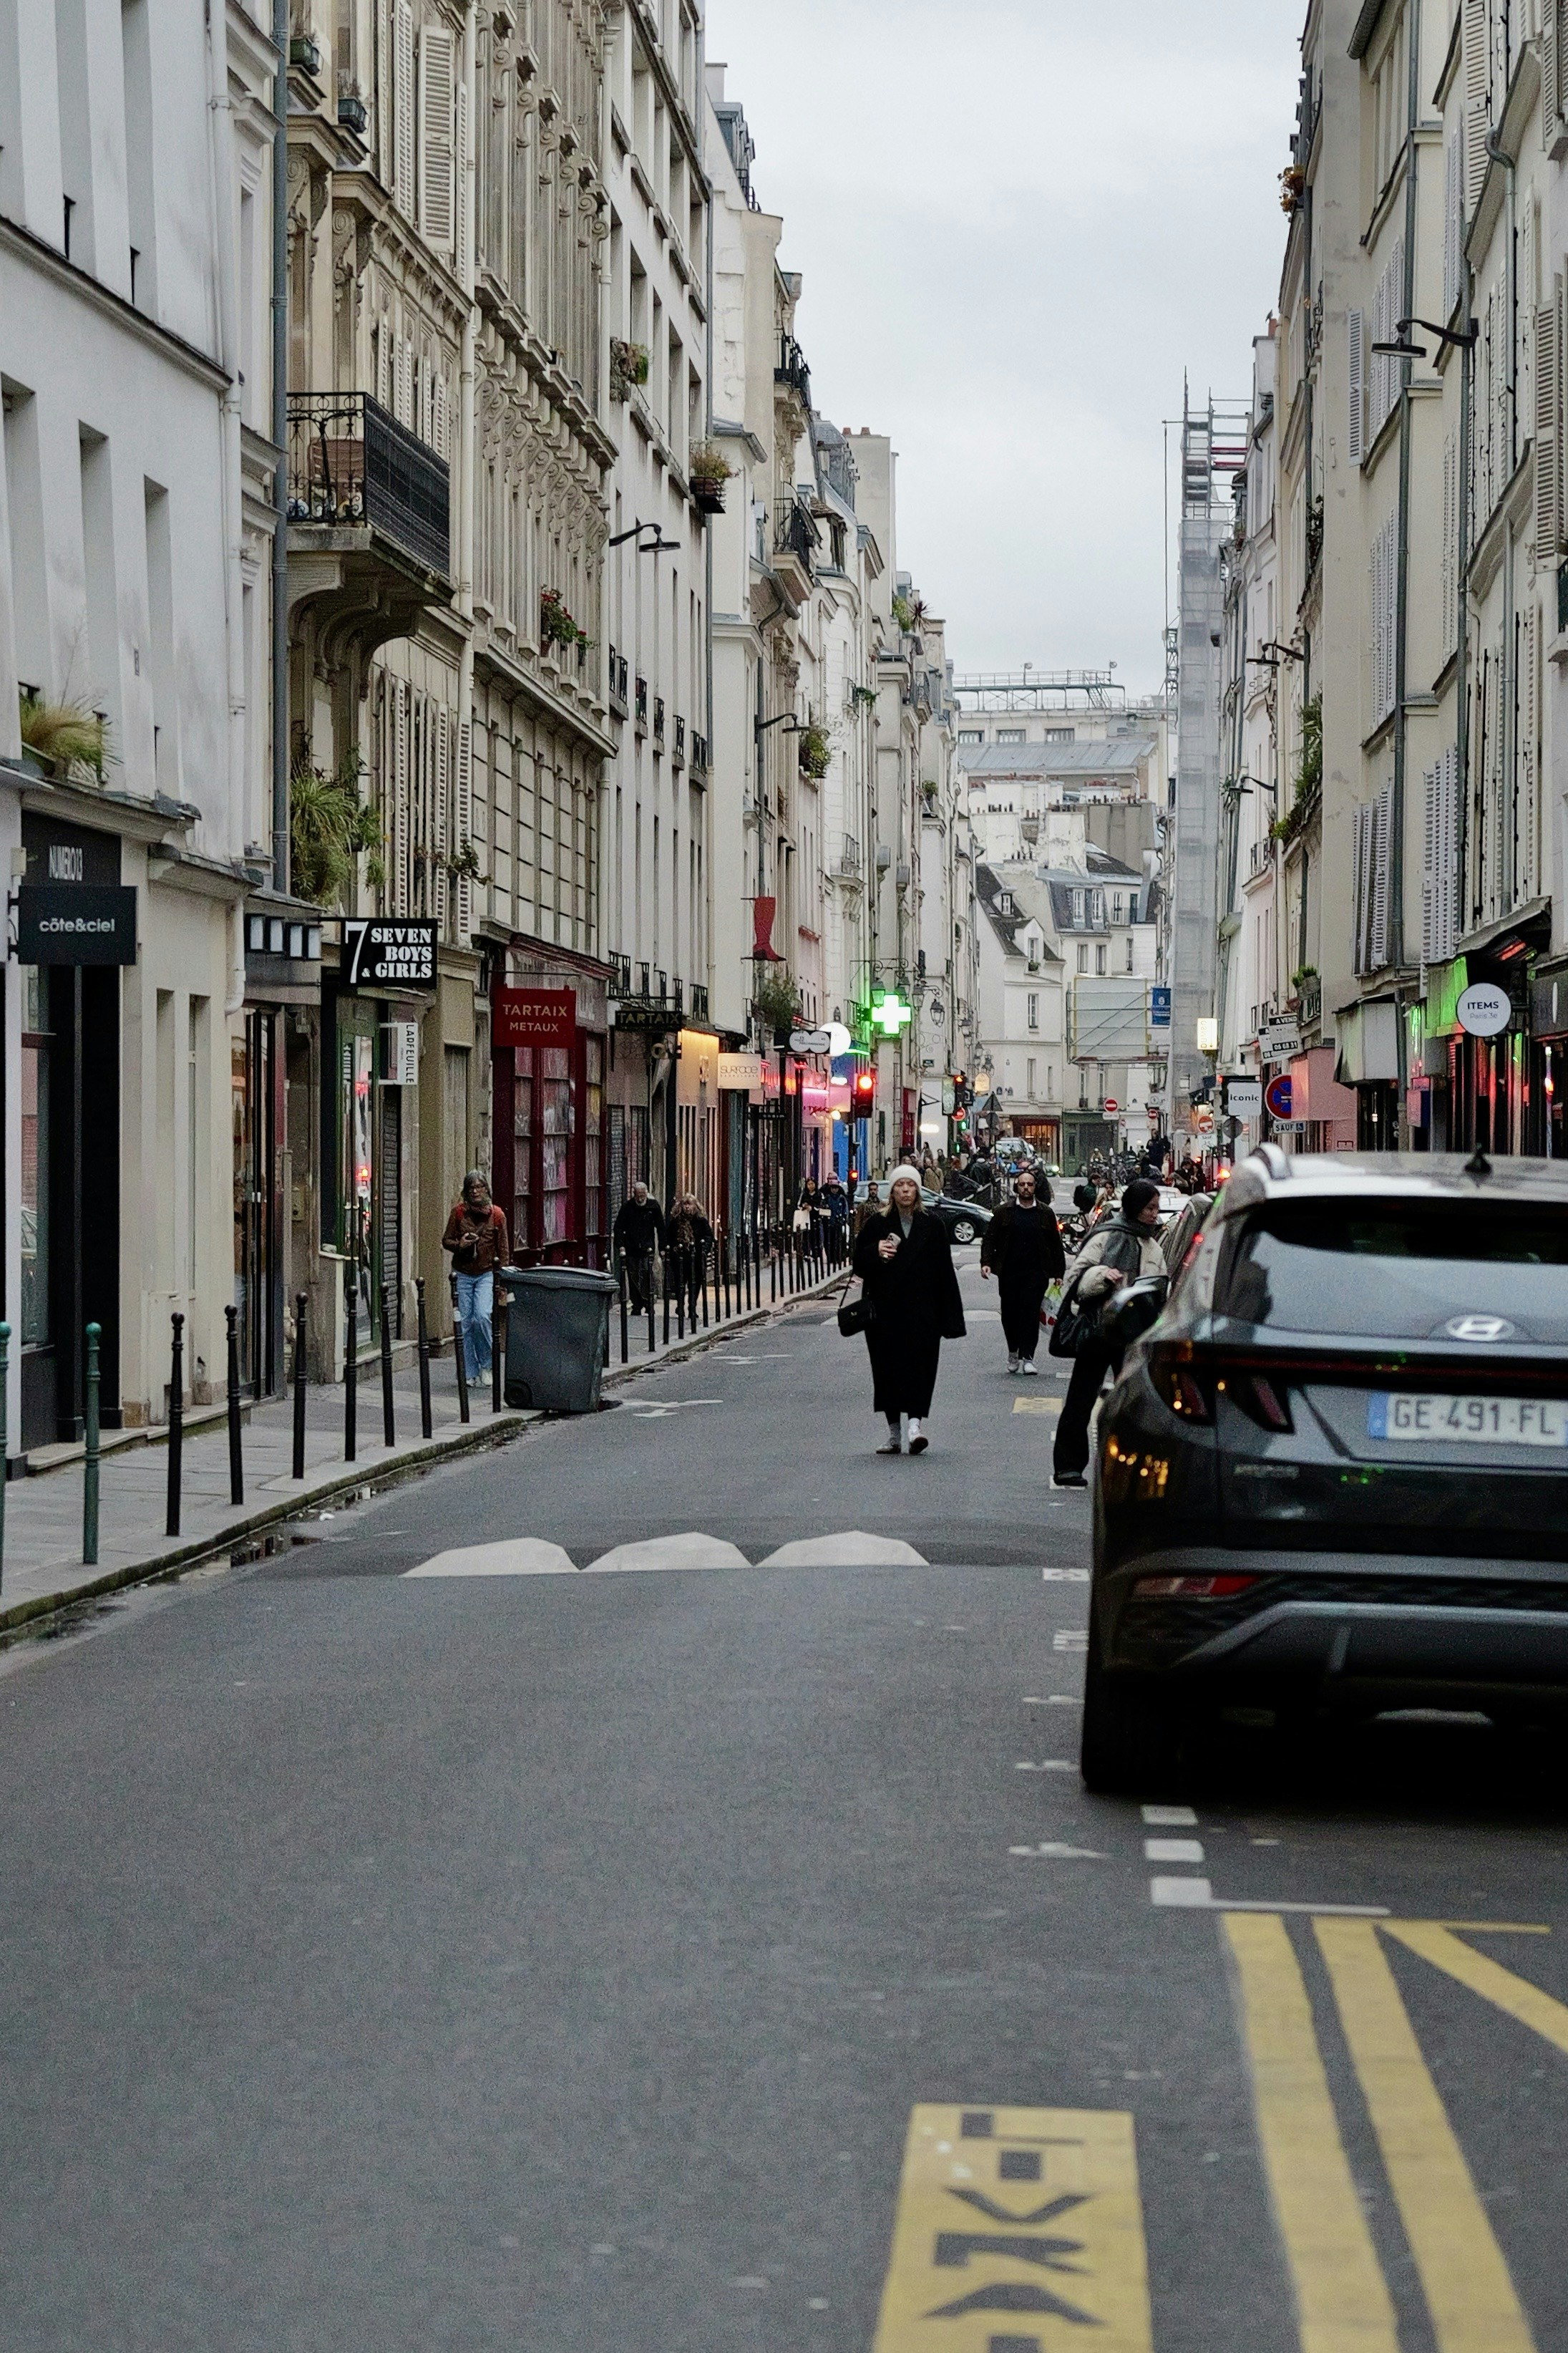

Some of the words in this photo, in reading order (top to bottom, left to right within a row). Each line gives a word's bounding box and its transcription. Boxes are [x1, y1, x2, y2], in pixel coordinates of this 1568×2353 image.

[371, 928, 432, 943] SEVEN
[345, 921, 369, 984] 7
[385, 946, 432, 961] BOYS
[361, 967, 371, 977] &
[375, 962, 432, 979] GIRLS
[502, 1004, 568, 1017] TARTAIX
[1467, 1001, 1499, 1010] ITEMS
[618, 1012, 679, 1024] TARTAIX
[510, 1022, 560, 1032] METAUX
